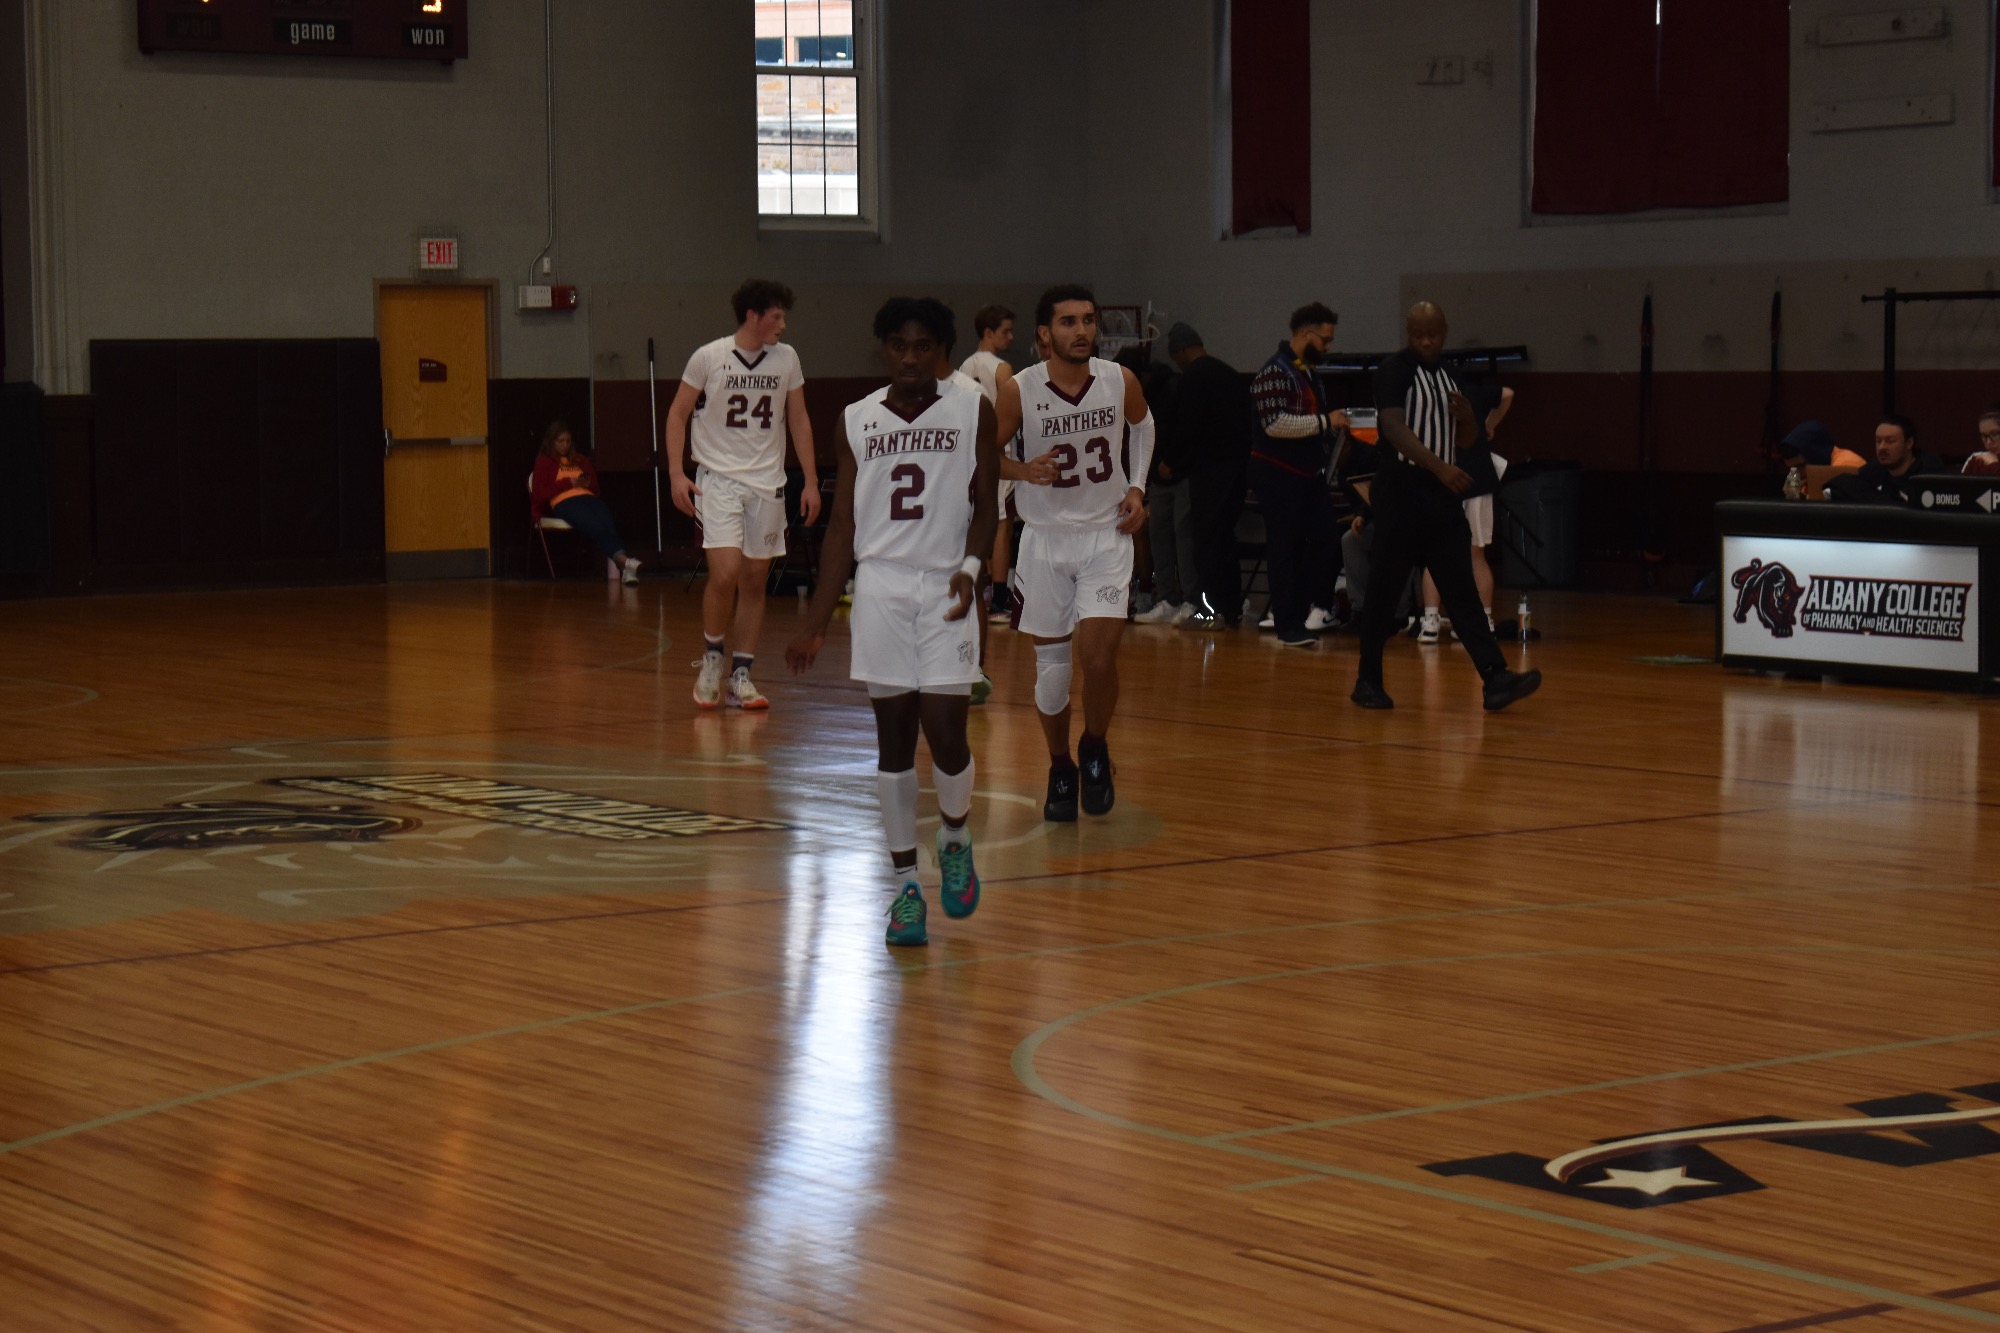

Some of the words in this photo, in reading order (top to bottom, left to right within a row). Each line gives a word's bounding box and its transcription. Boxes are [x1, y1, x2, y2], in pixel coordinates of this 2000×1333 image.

[290, 22, 336, 45] game
[411, 27, 445, 46] won
[427, 240, 454, 264] EXIT
[726, 375, 778, 389] PANTHERS
[726, 394, 774, 429] 24
[1044, 408, 1115, 436] PANTHERS
[868, 430, 957, 458] PANTHERS
[1051, 436, 1114, 488] 23
[890, 463, 926, 520] 2
[1935, 493, 1961, 506] BONUS
[1806, 578, 1886, 614] ALBANY
[1885, 583, 1966, 619] COLLEGE
[1803, 613, 1811, 625] OF
[1811, 612, 1864, 631] PHARMACY
[1862, 617, 1875, 629] AND
[1876, 616, 1914, 634] HEALTH
[1915, 618, 1962, 638] SCIENCES
